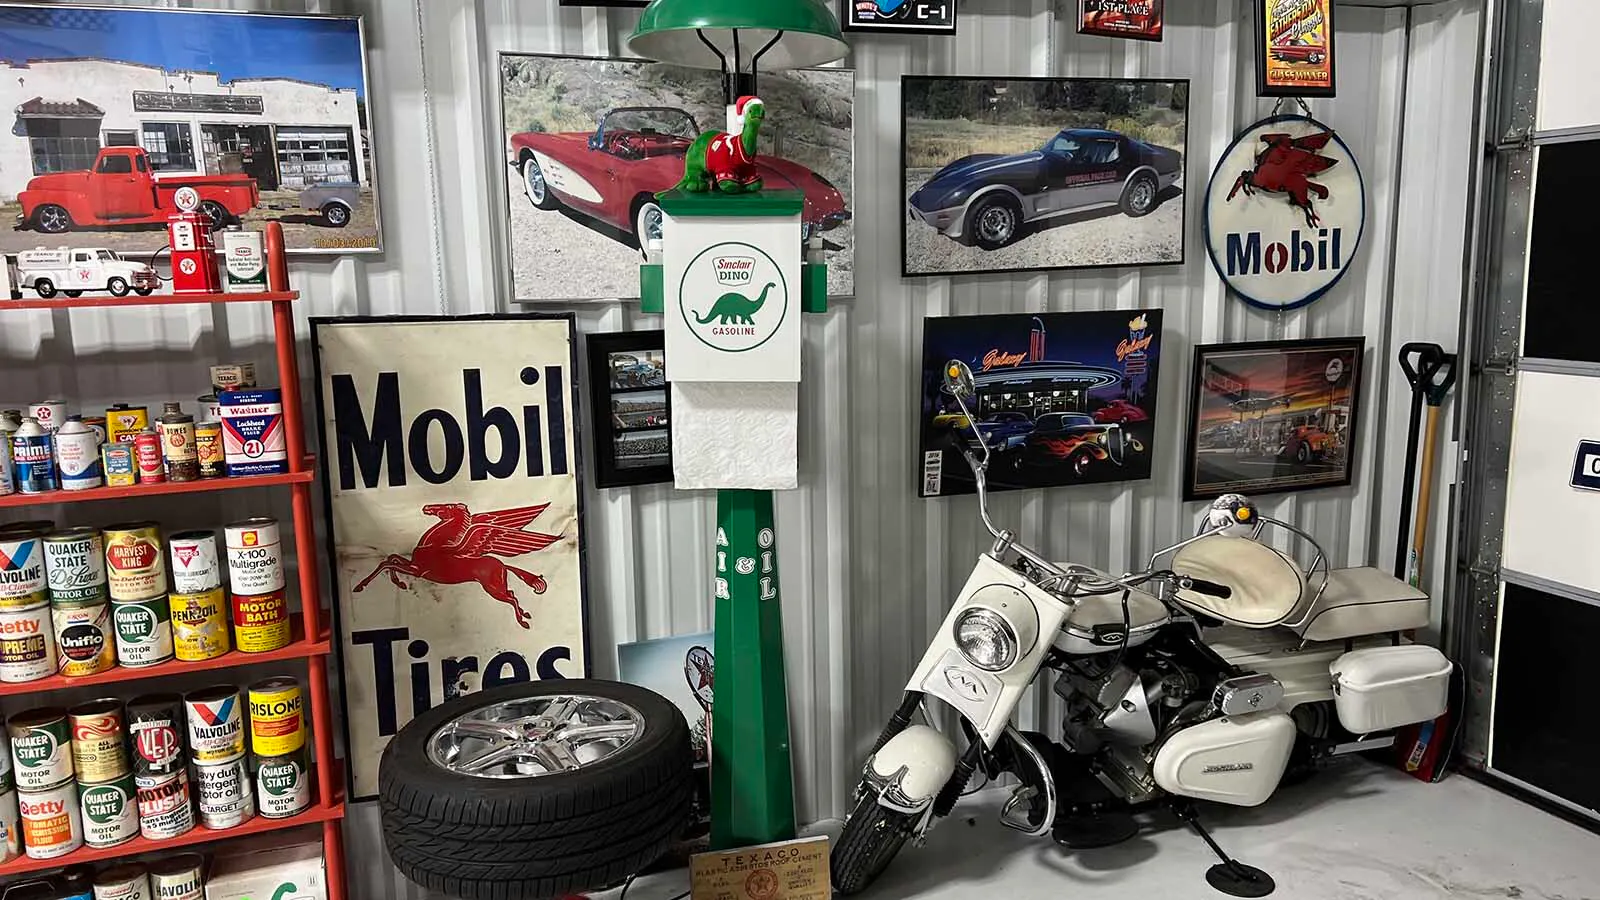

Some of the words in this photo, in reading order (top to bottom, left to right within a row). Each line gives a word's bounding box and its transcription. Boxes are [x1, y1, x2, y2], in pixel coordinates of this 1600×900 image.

[917, 4, 947, 20] C-1
[1098, 2, 1115, 12] 1ST
[1117, 4, 1149, 17] PLACE
[1226, 227, 1342, 277] Mobil
[717, 258, 752, 270] Sinclair
[719, 271, 749, 280] DINO
[712, 327, 755, 336] GASOLINE
[983, 348, 1028, 372] Galaxy
[217, 374, 238, 382] TEXACO
[230, 407, 269, 416] Wagner
[331, 366, 568, 490] Mobil
[13, 446, 50, 456] PRIME
[245, 442, 261, 454] 21
[48, 542, 91, 556] QUAKER
[113, 545, 148, 557] HARVEST
[237, 548, 267, 560] X-100
[55, 555, 88, 569] STATE
[122, 556, 143, 568] KING
[230, 557, 277, 570] Multigrade
[714, 526, 730, 600] AIR
[735, 556, 756, 575] &
[757, 527, 777, 600] OIL
[0, 564, 41, 585] LVOLINE
[53, 590, 82, 599] MOTOR
[85, 588, 99, 597] OIL
[239, 599, 281, 613] MOTOR
[117, 612, 149, 622] QUAKER
[246, 610, 278, 622] BATH
[120, 623, 147, 635] STATE
[0, 637, 44, 655] UPREME
[61, 635, 103, 647] Uniflo
[122, 646, 151, 654] MOTOR
[250, 696, 301, 716] RISLONE
[193, 717, 241, 739] VALVOLINE
[14, 735, 49, 747] QUAKER
[18, 748, 47, 760] STATE
[20, 769, 51, 778] MOTOR
[199, 771, 215, 781] avy
[217, 766, 241, 779] duty
[262, 765, 293, 776] QUAKER
[200, 778, 240, 790] tergent
[267, 776, 292, 788] STATE
[85, 791, 119, 804] QUAKER
[201, 791, 223, 799] otor
[225, 785, 238, 797] oil
[20, 799, 65, 815] Getty
[268, 796, 295, 806] MOTOR
[90, 803, 117, 816] STATE
[207, 802, 238, 813] TARGET
[91, 825, 121, 834] MOTOR
[721, 847, 800, 867] TEXACO
[156, 878, 200, 897] HAVOLIN
